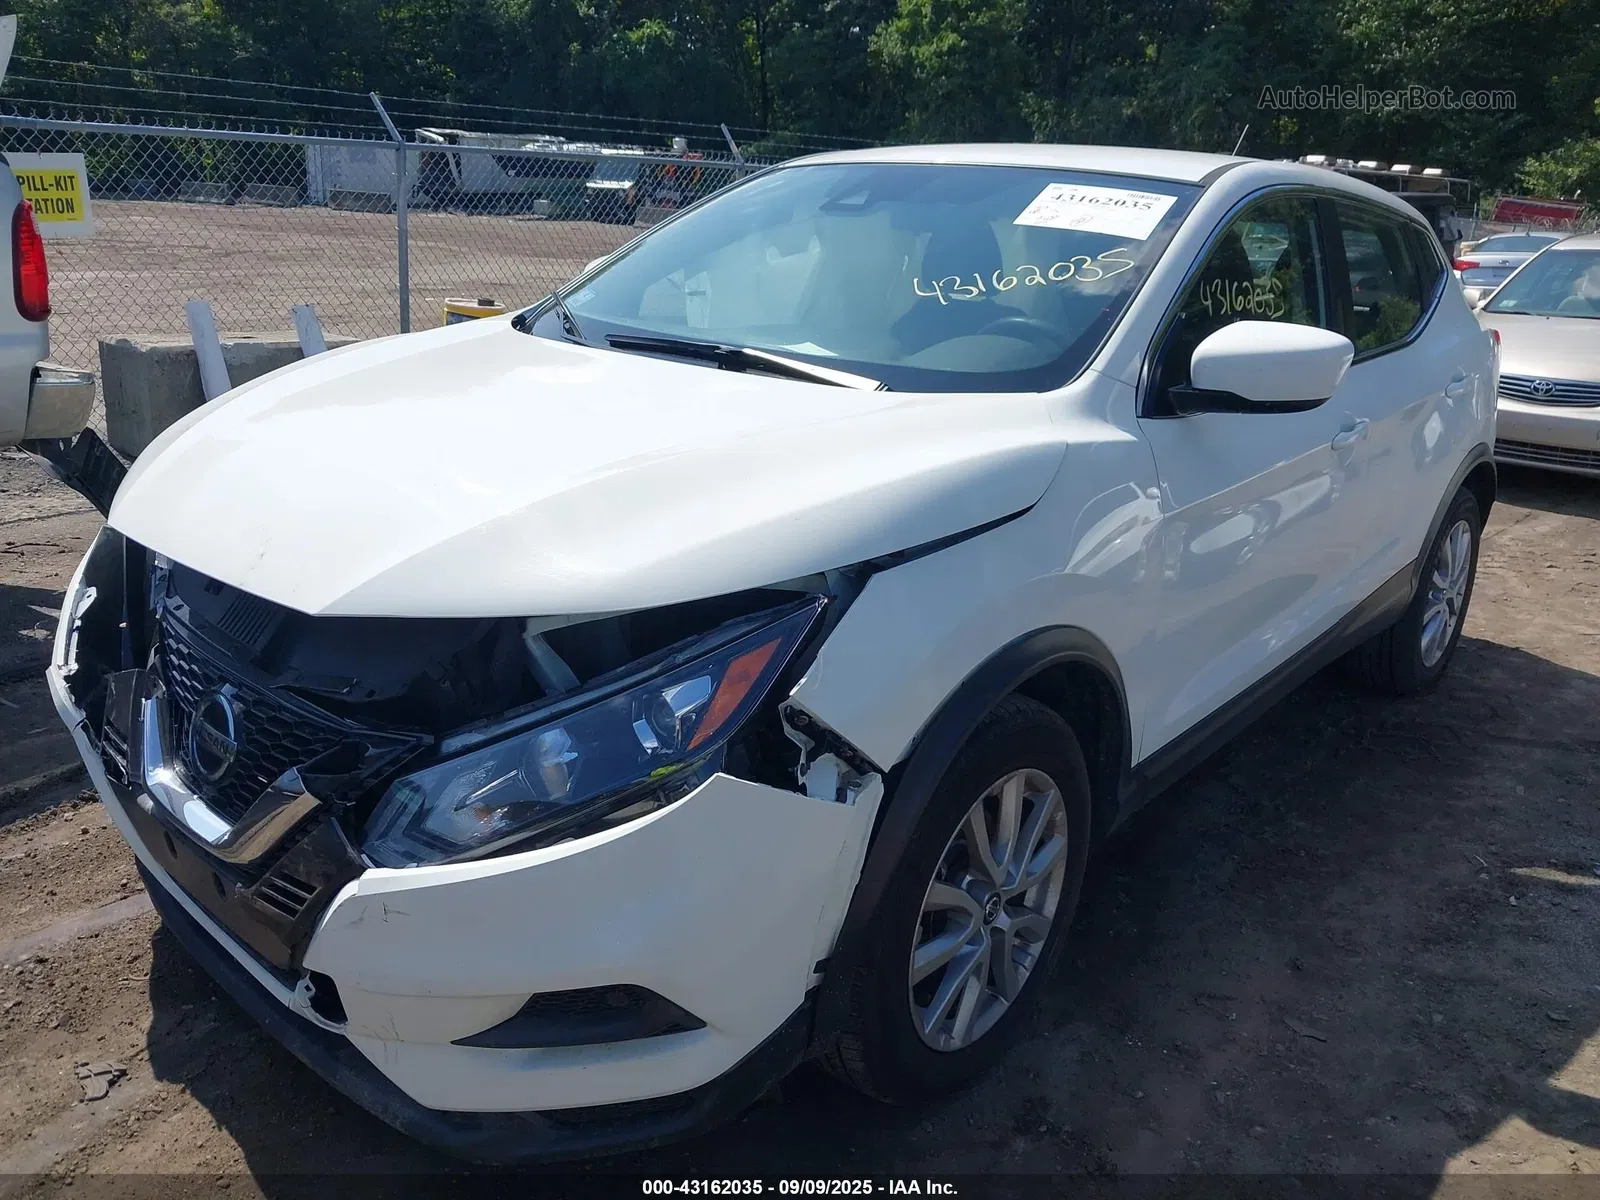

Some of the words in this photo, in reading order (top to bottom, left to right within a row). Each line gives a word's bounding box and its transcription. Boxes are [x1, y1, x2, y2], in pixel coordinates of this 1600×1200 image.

[25, 197, 75, 214] ATION
[1050, 193, 1154, 211] 43162035
[913, 248, 1135, 305] 43162035
